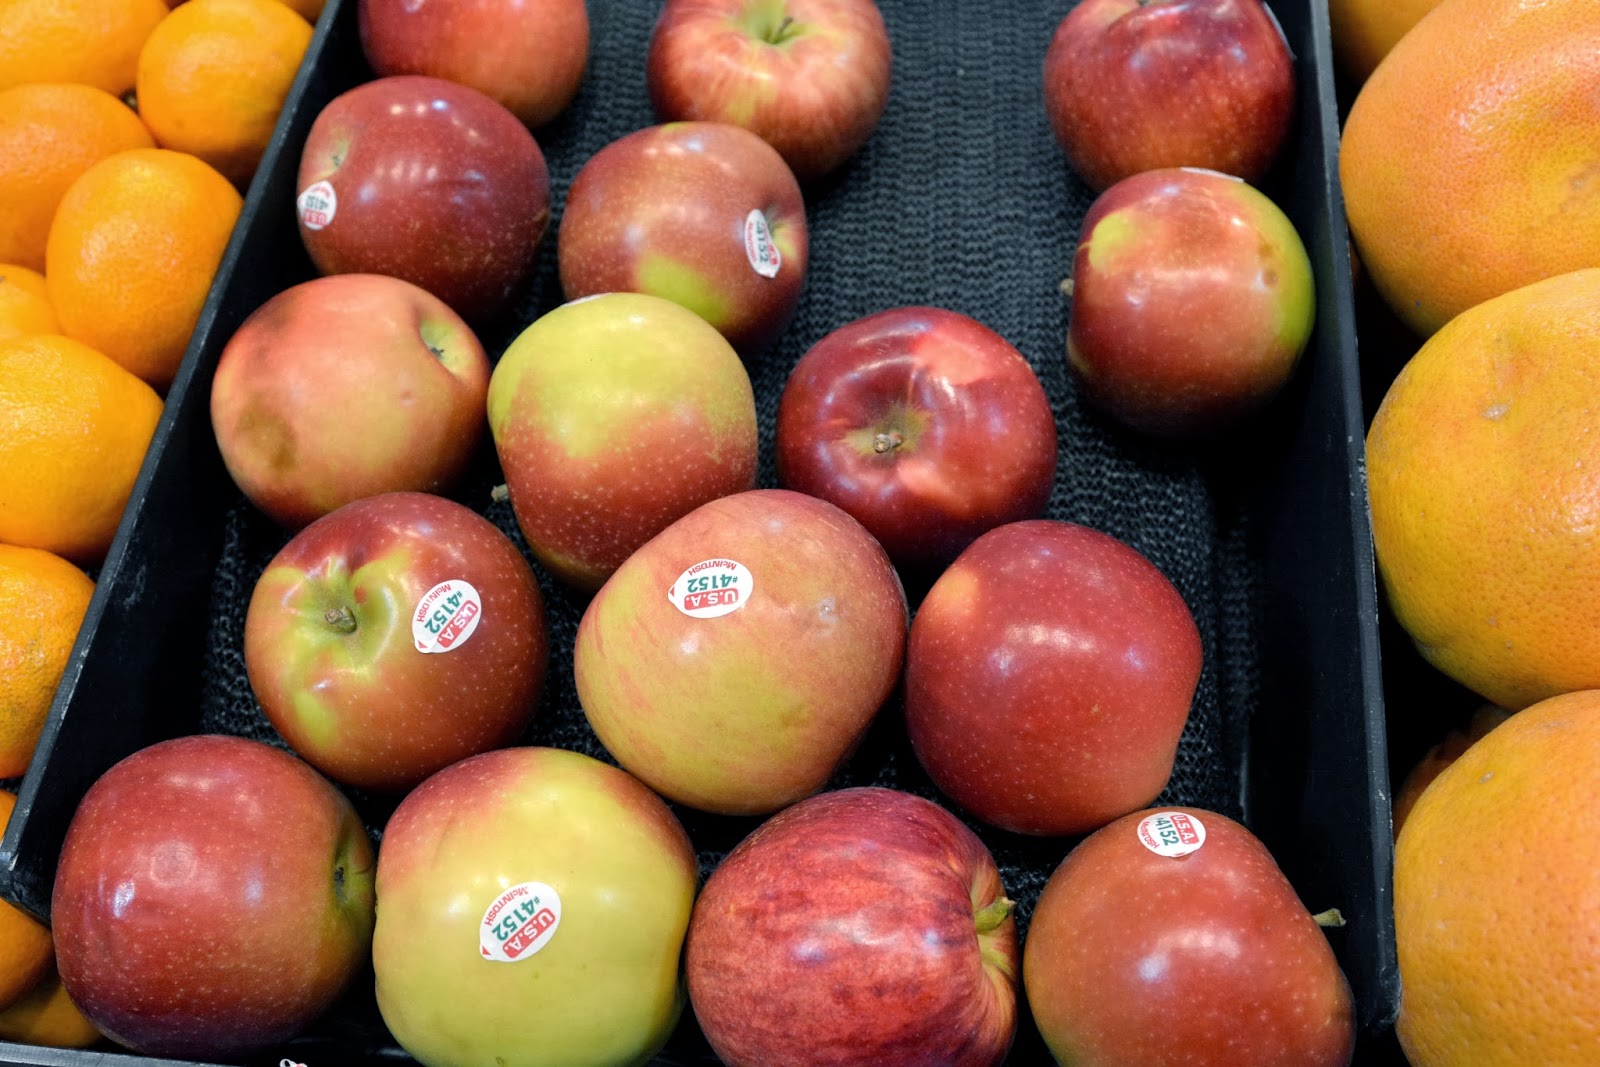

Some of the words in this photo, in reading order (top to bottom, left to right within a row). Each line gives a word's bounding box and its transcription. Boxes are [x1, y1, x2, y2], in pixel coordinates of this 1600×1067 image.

[687, 574, 738, 593] #4152
[688, 560, 737, 576] McINTOSH
[424, 590, 463, 634] #4152
[685, 590, 736, 607] U.S.A.
[1173, 815, 1196, 845] U.S.A.
[484, 886, 529, 927] McINTOSH
[491, 896, 541, 942] #4152
[503, 911, 554, 952] U.S.A.
